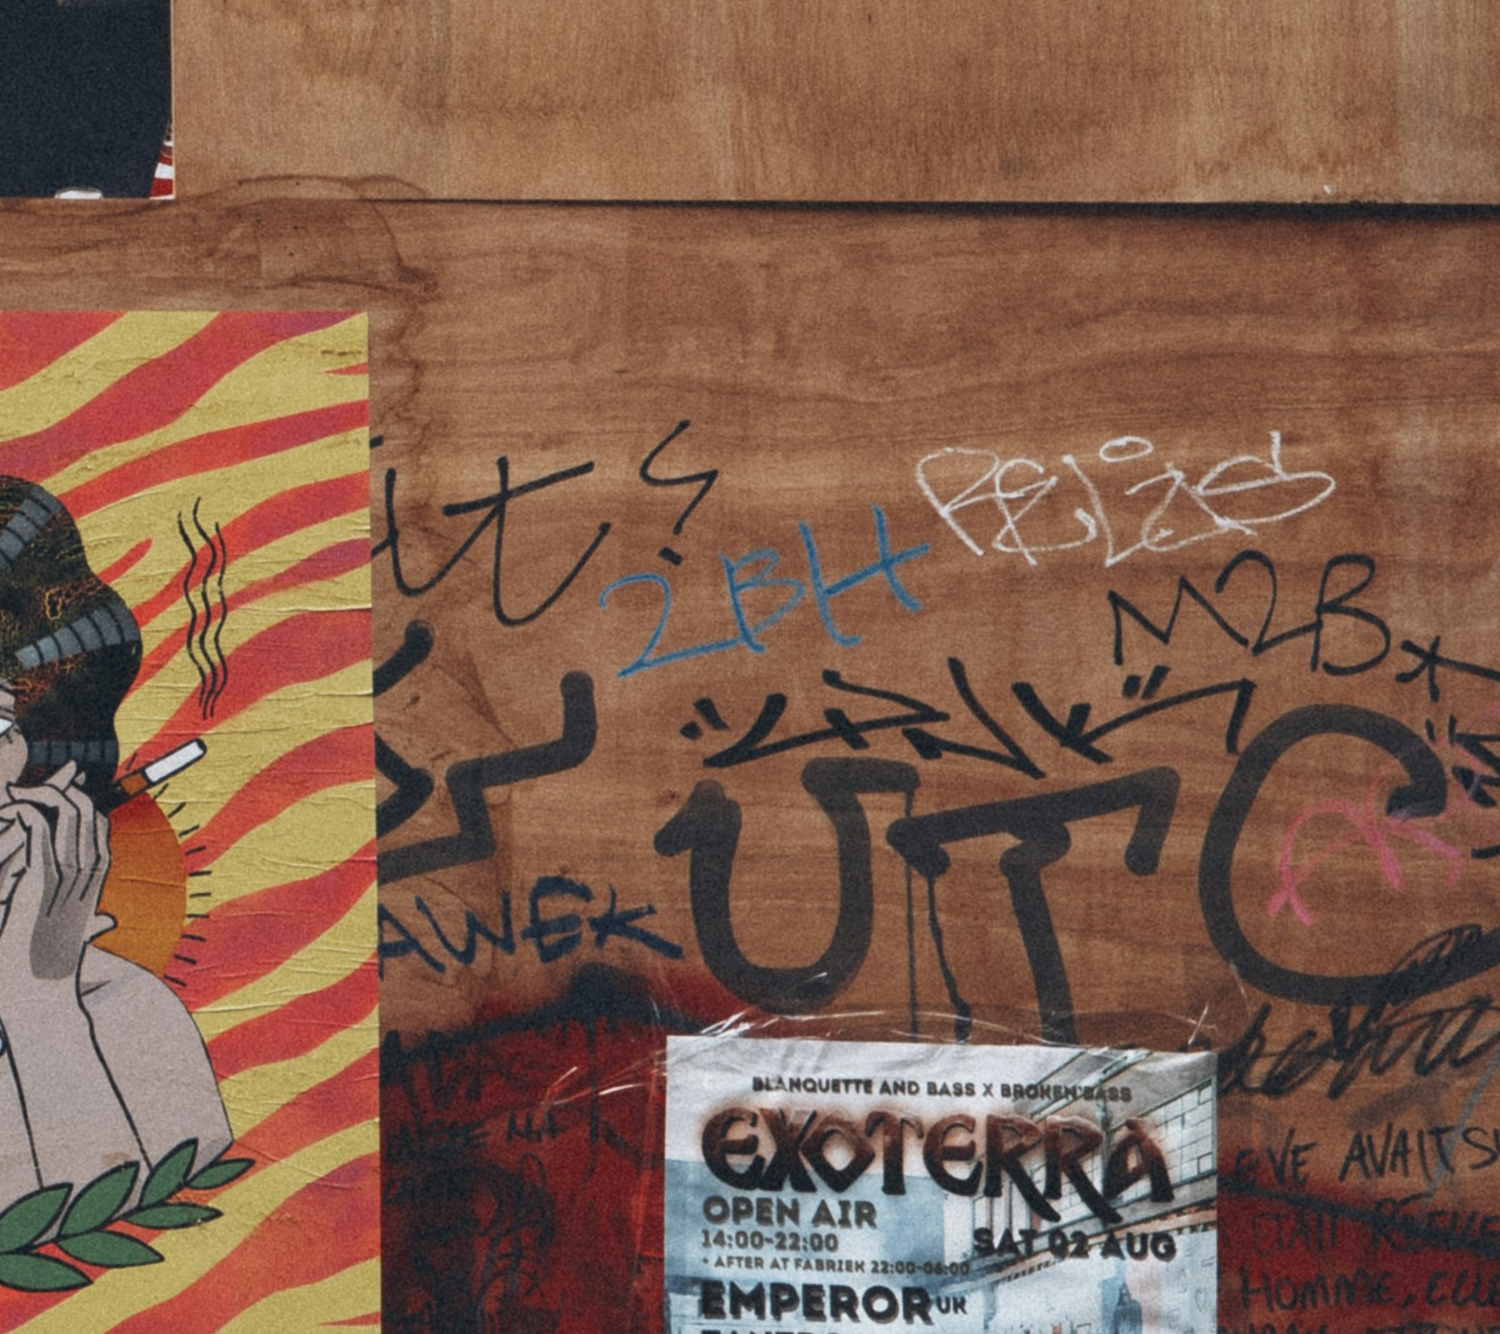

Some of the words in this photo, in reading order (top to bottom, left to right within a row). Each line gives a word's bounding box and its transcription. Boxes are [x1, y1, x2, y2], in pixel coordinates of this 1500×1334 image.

[752, 1076, 874, 1095] BLANQUETTE
[880, 1078, 920, 1095] AND
[926, 1081, 976, 1097] BASS
[983, 1083, 994, 1098] X
[701, 1106, 1176, 1223] EXOTERRA
[702, 1195, 798, 1227] OPEN
[812, 1199, 878, 1229] AIR
[702, 1230, 839, 1252] 14:00-22:00
[973, 1227, 1039, 1256] SAT
[1049, 1230, 1090, 1258] 02
[1101, 1232, 1177, 1261] AUG
[715, 1255, 765, 1271] AFTER
[771, 1257, 791, 1271] AT
[795, 1257, 865, 1274] FABRIEK
[871, 1259, 970, 1276] 22:00-06:00
[700, 1282, 935, 1325] EMPEROR
[936, 1296, 967, 1316] UK
